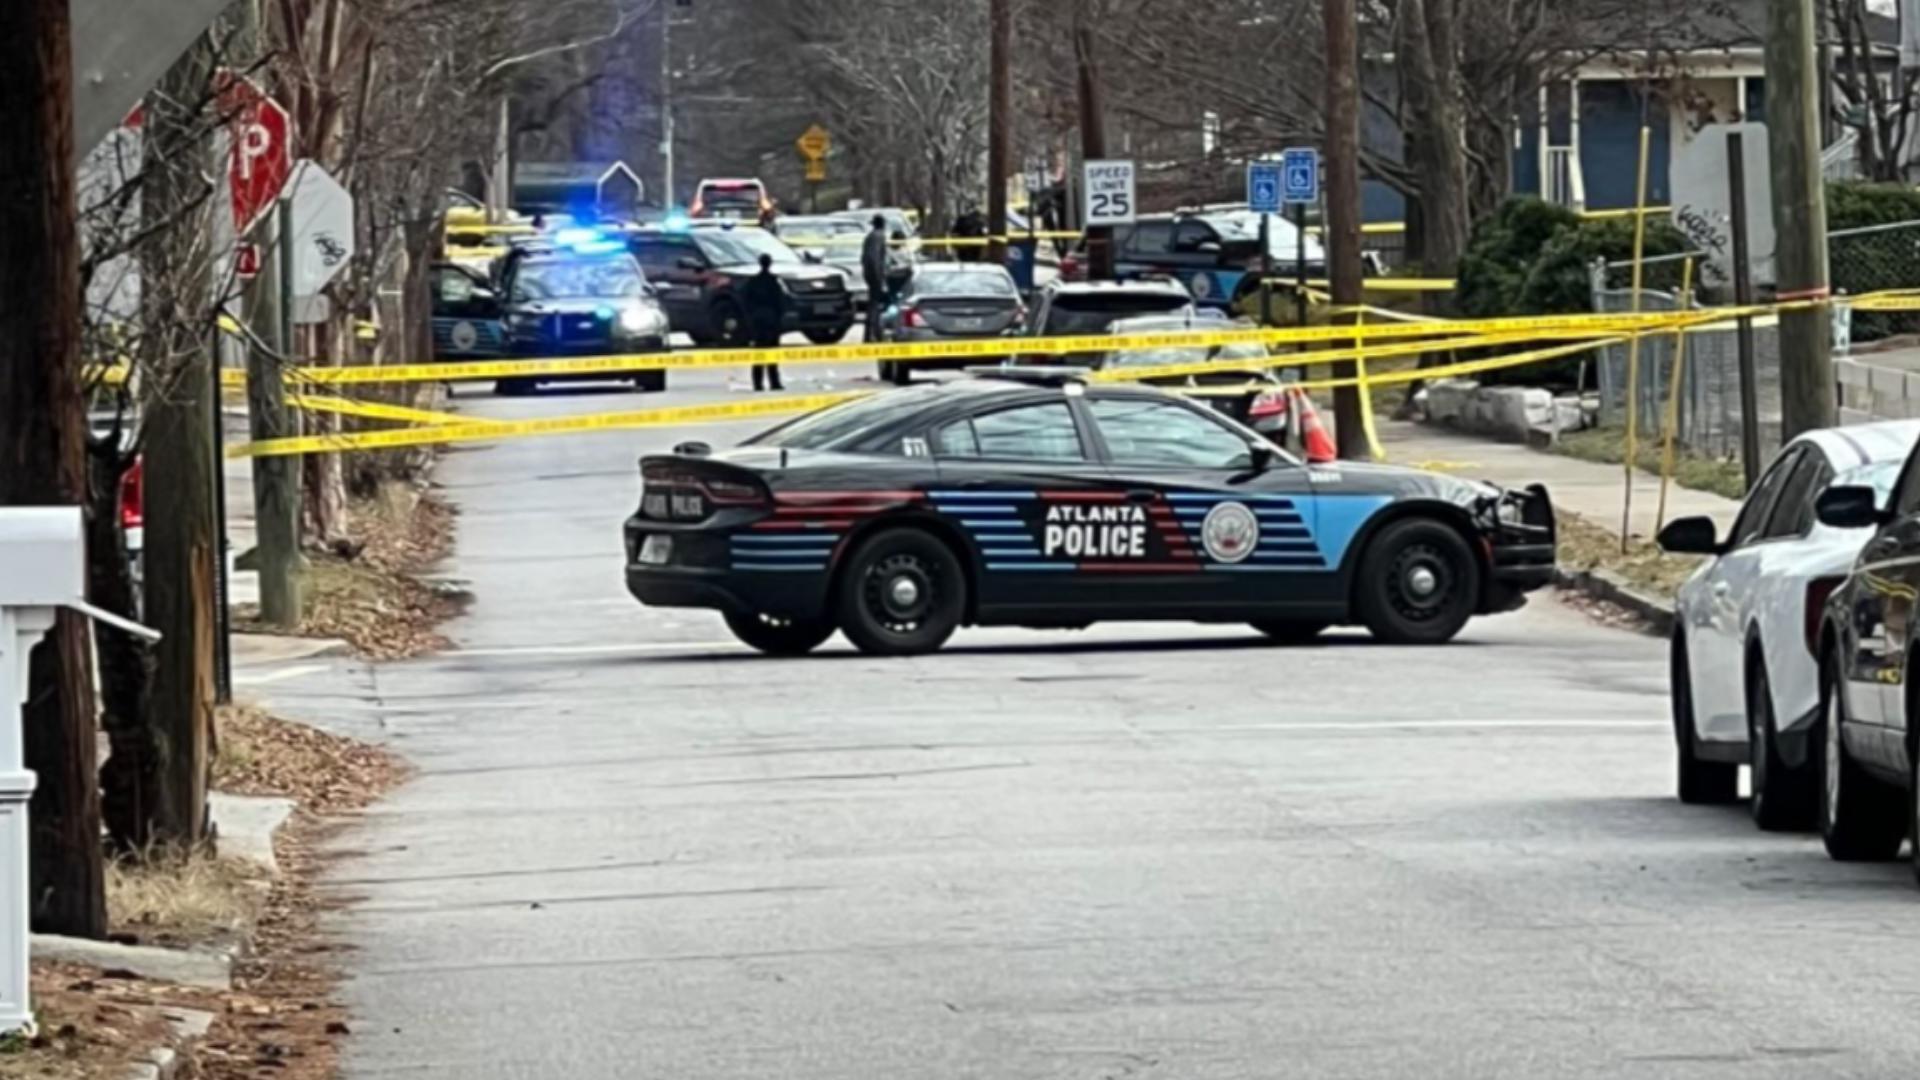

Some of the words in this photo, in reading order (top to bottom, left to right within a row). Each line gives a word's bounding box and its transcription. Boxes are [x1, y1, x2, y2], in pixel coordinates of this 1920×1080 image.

[1088, 166, 1130, 178] SPEED
[1092, 180, 1125, 191] LIMIT
[1091, 193, 1129, 217] 25
[1046, 506, 1145, 522] ATLANTA
[1045, 525, 1146, 556] POLICE
